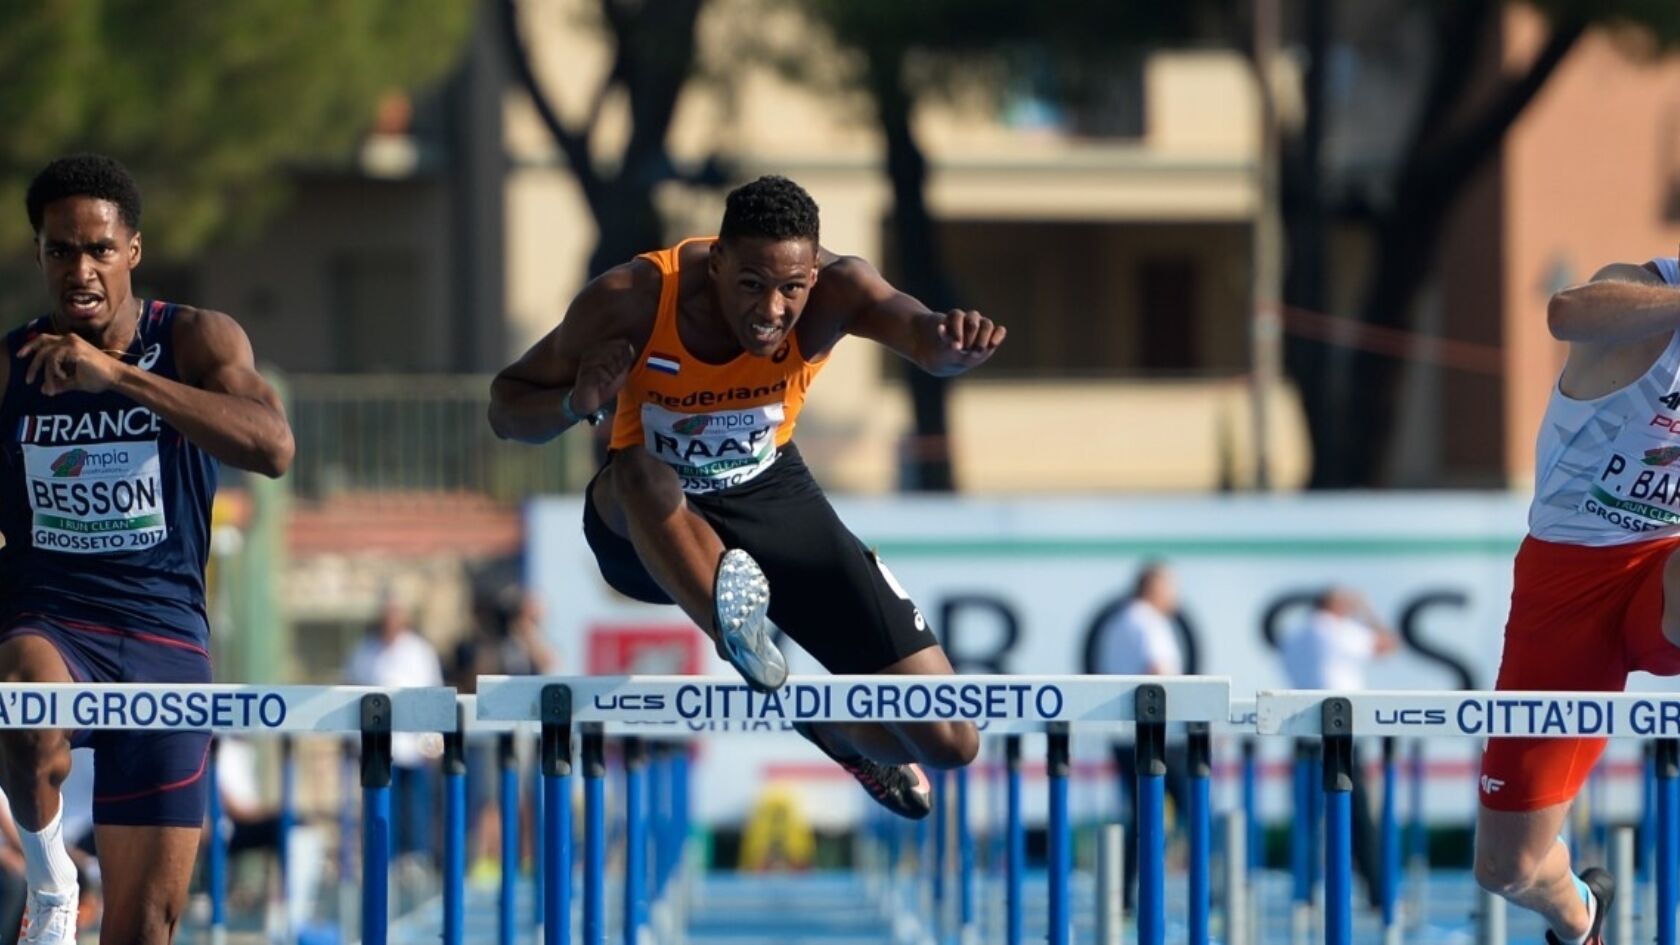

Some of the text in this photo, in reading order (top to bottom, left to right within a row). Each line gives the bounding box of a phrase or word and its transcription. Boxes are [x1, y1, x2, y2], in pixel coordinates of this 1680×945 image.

[654, 425, 770, 461] RAAP
[32, 477, 156, 516] BESSON
[681, 474, 743, 490] OSSETO
[66, 520, 88, 532] RUN
[91, 520, 129, 531] CLEAN
[1621, 502, 1648, 515] RUN
[35, 530, 164, 549] GROSSETO 2017
[72, 691, 287, 727] GROSSETO
[594, 695, 665, 710] UCS
[847, 684, 1063, 719] GROSSETO
[1375, 709, 1446, 724] UCS
[1457, 699, 1613, 735] CITTA'DI
